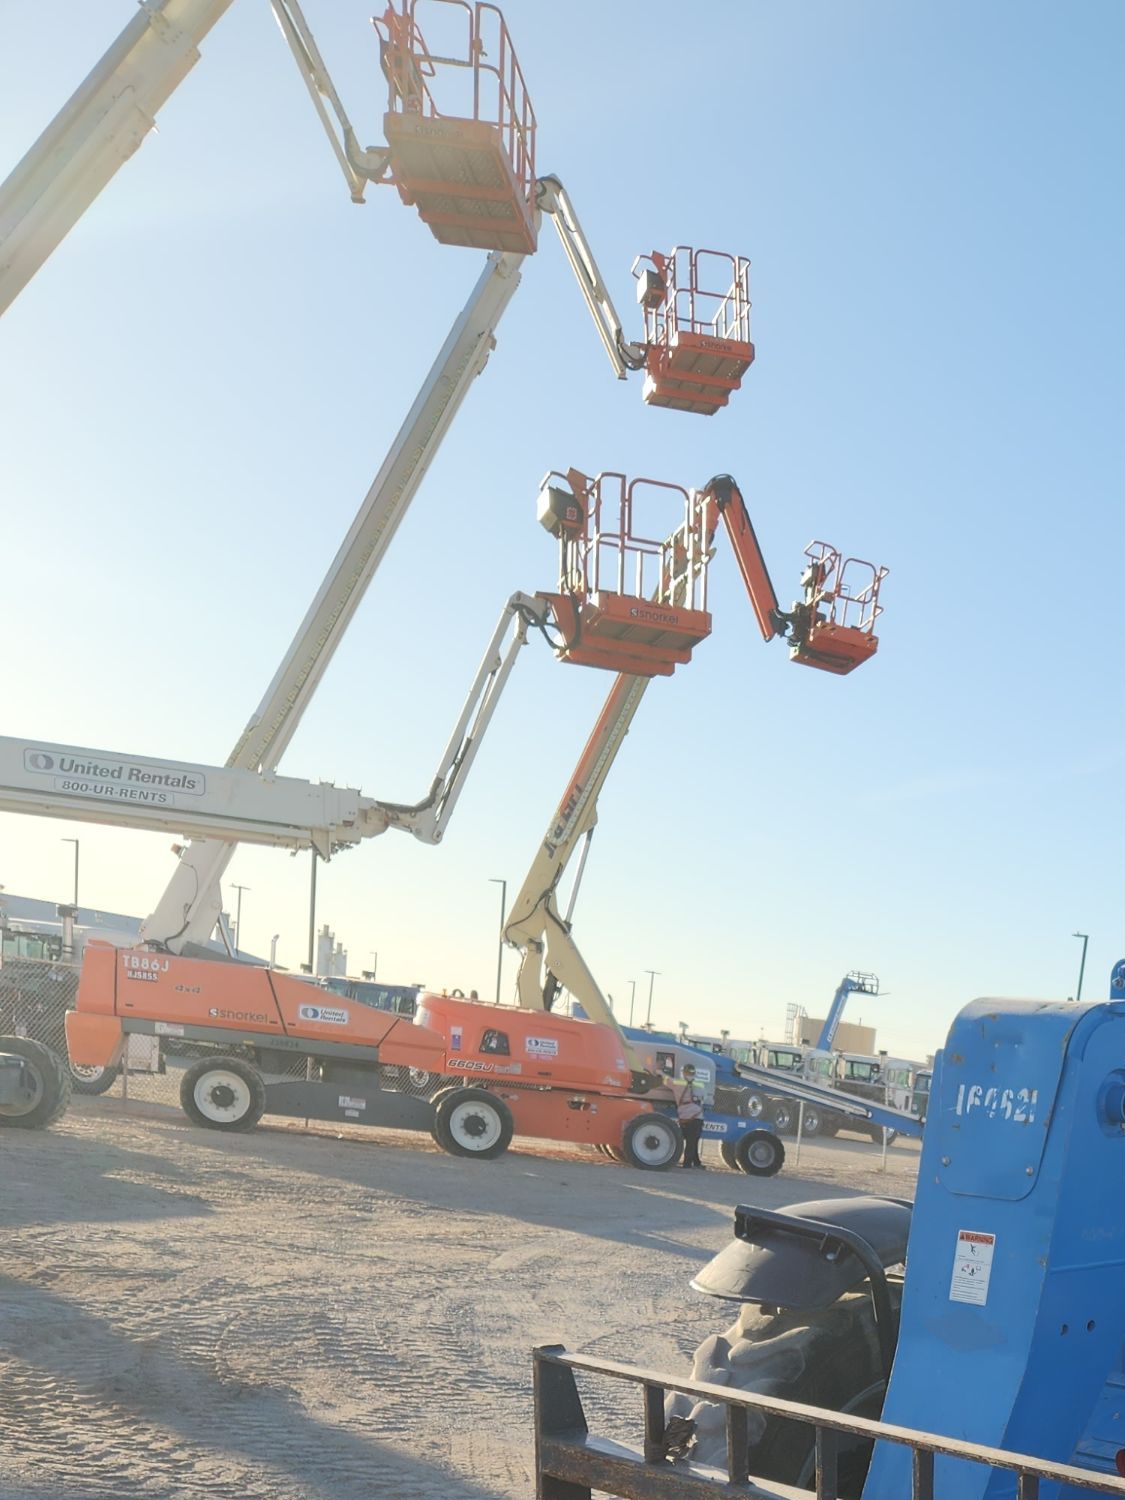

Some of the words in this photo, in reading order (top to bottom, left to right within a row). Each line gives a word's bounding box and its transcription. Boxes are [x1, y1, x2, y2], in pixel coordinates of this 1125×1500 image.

[58, 757, 124, 780] United
[127, 768, 198, 790] Rentals
[61, 780, 168, 803] 800-UR-RENTS
[122, 954, 169, 973] TB86J
[220, 1008, 268, 1025] snorkel
